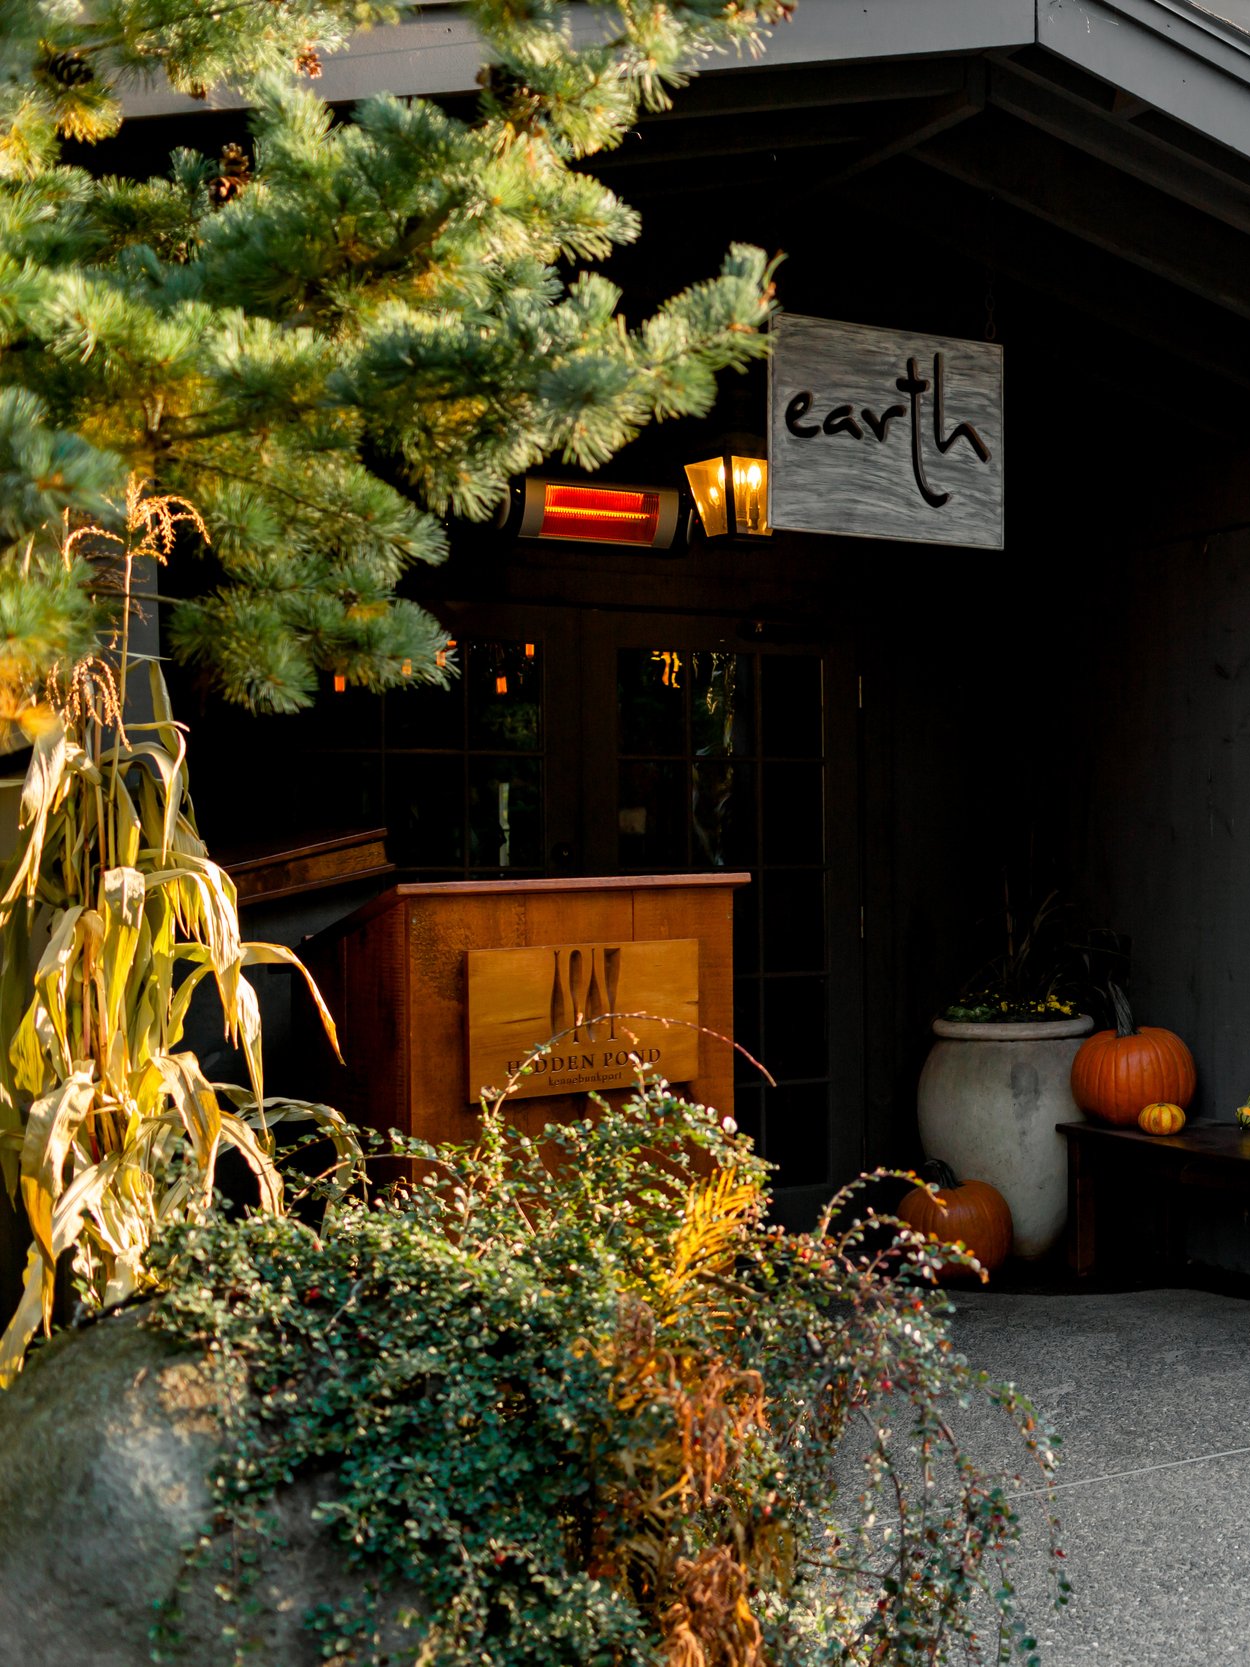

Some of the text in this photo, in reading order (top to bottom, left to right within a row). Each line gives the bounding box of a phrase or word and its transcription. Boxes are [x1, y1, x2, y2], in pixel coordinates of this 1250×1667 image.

[784, 352, 992, 508] earth
[506, 1048, 661, 1076] HDDEN POND
